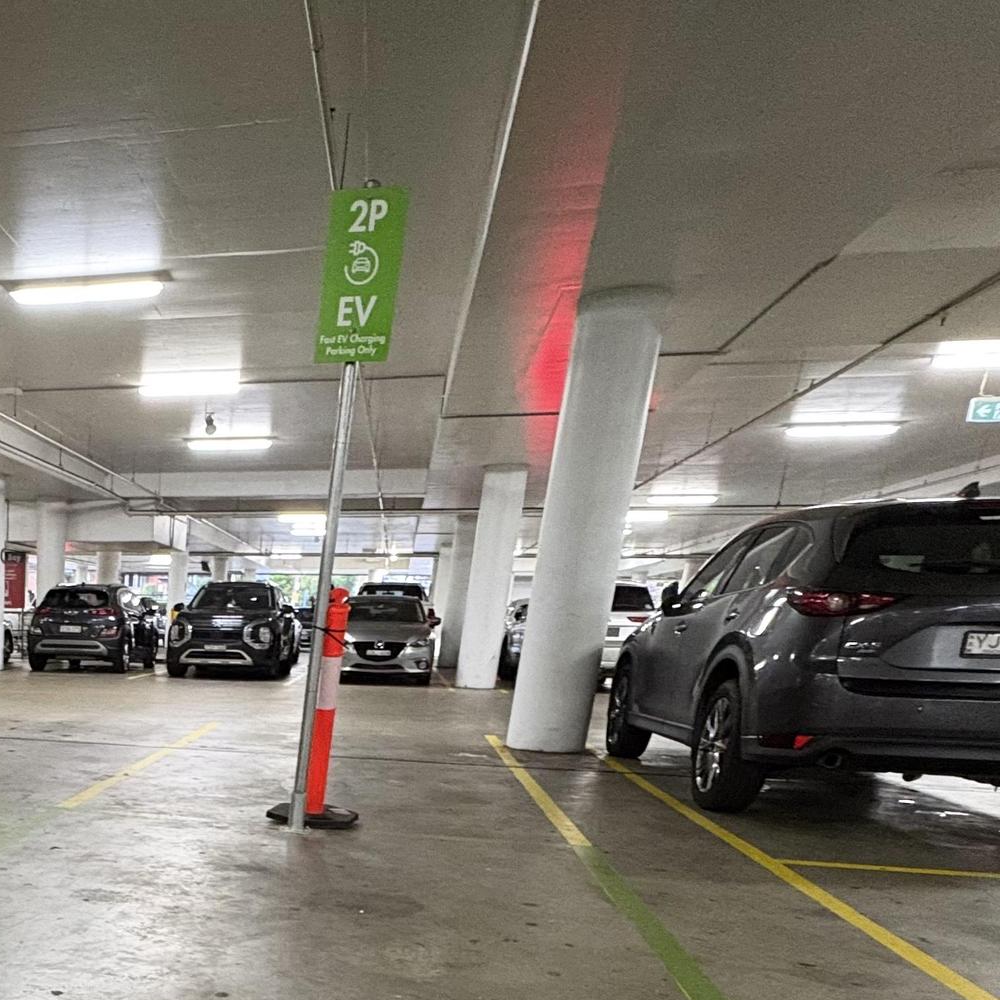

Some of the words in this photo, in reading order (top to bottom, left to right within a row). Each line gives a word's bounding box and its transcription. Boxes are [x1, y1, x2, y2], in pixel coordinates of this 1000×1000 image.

[348, 199, 388, 233] 2P
[336, 295, 378, 327] EV
[319, 334, 336, 345] Fast
[337, 334, 349, 344] EV
[349, 333, 386, 345] Charging
[326, 345, 356, 357] Parking
[357, 344, 377, 356] Only
